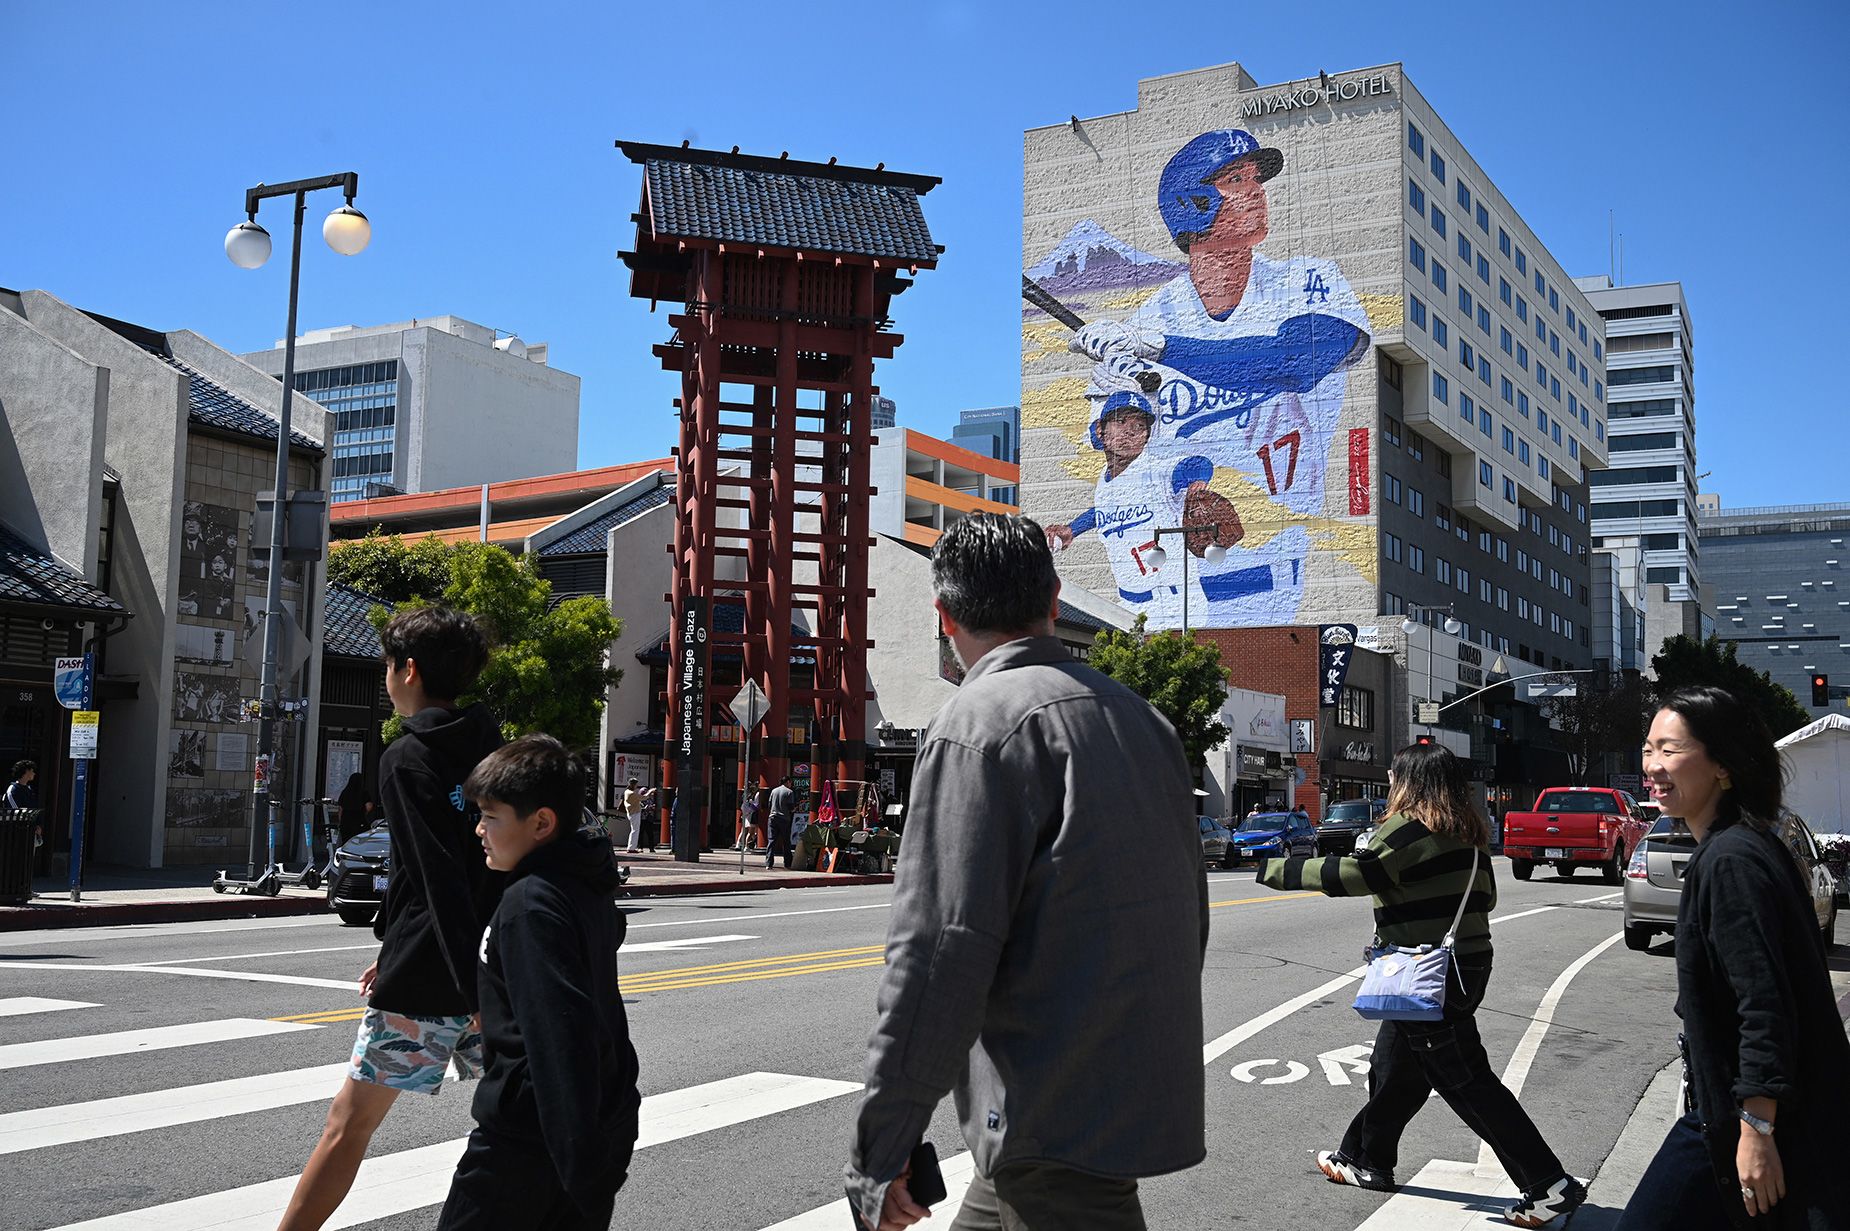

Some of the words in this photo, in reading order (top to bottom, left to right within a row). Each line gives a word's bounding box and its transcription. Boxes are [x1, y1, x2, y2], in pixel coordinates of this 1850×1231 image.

[1240, 87, 1319, 120] MIYAKO
[1325, 74, 1391, 103] HOTEL
[1303, 268, 1330, 305] LA
[1256, 429, 1301, 495] 17
[1095, 504, 1153, 538] Dodgers
[684, 608, 696, 643] Plaza
[1357, 634, 1378, 645] Vargas
[57, 659, 84, 669] DASH
[682, 648, 696, 690] Village
[1322, 649, 1346, 705] 文化堂
[19, 692, 33, 702] 358
[681, 694, 693, 756] Japanese
